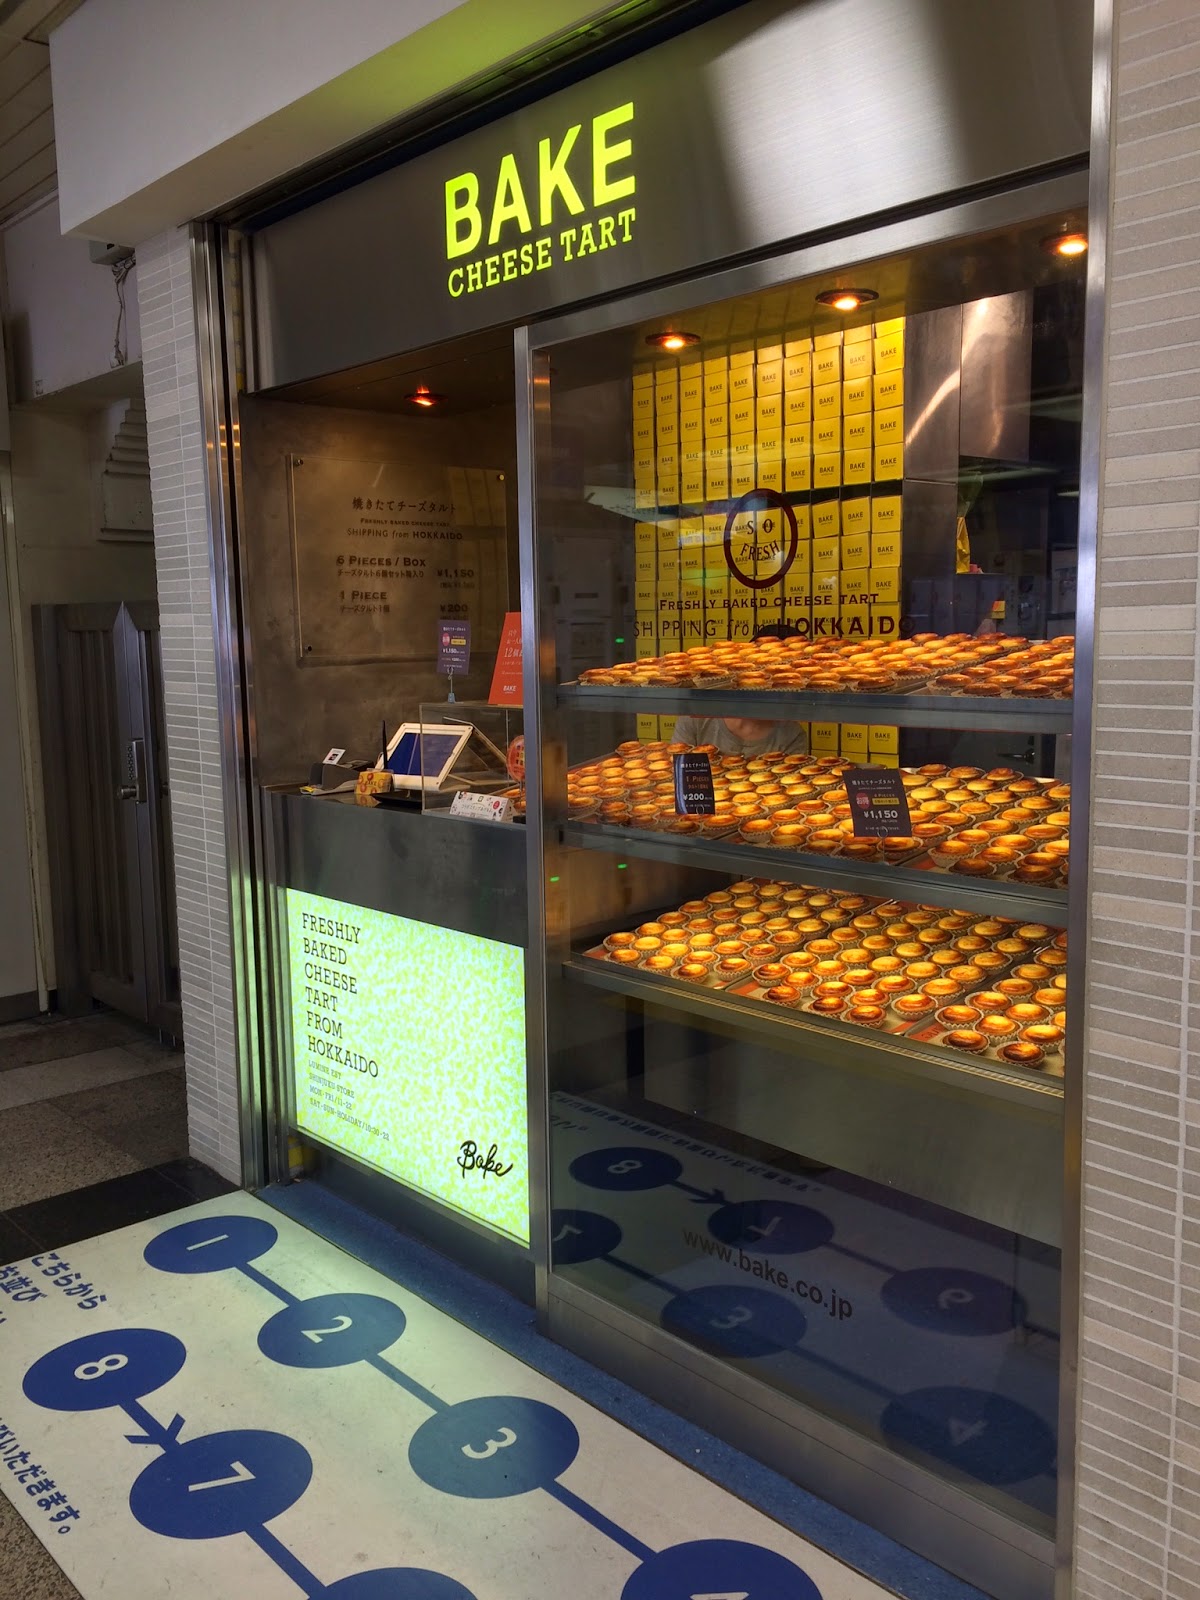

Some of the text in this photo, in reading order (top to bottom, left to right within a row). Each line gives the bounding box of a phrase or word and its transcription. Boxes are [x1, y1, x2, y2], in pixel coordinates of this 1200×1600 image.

[445, 101, 636, 260] BAKE
[448, 207, 636, 298] CHEESE TART
[880, 347, 897, 357] BAKE
[850, 355, 866, 364] BAKE
[818, 361, 834, 370] BAKE
[789, 367, 804, 376] BAKE
[762, 373, 777, 381] BAKE
[734, 379, 748, 387] BAKE
[709, 384, 723, 392] BAKE
[880, 384, 896, 393] BAKE
[660, 394, 673, 402] BAKE
[848, 391, 864, 400] BAKE
[637, 399, 650, 407] BAKE
[819, 396, 834, 405] BAKE
[790, 402, 805, 410] BAKE
[880, 421, 897, 430] BAKE
[818, 431, 834, 439] BAKE
[849, 427, 865, 435] BAKE
[762, 440, 776, 448] BAKE
[790, 436, 804, 444] BAKE
[736, 444, 749, 452] BAKE
[880, 457, 897, 465] BAKE
[850, 462, 865, 470] BAKE
[352, 496, 456, 514] 焼きたてチーズタルト
[818, 515, 833, 523] BAKE
[848, 512, 863, 520] BAKE
[347, 528, 463, 540] SHIPPING from HOKKAIDO
[740, 539, 780, 560] FRESH
[818, 550, 833, 558] BAKE
[336, 555, 426, 567] 6 PIECES / BOX
[438, 569, 474, 578] ¥1,150
[340, 590, 387, 600] 1 PIECE
[660, 594, 879, 610] FRESHLY BAKED CHEESE TART
[440, 604, 468, 612] ¥200
[633, 619, 716, 637] SHIPPING
[777, 616, 915, 636] HOKKAIDO
[864, 810, 898, 819] ¥1,150
[302, 912, 361, 944] FRESHLY
[303, 937, 348, 965] BAKED
[304, 962, 358, 995] CHEESE
[305, 986, 338, 1012] TART
[307, 1011, 343, 1039] FROM
[307, 1035, 379, 1078] HOKKAIDO
[457, 1140, 513, 1179] Bake
[186, 1234, 230, 1252] 1
[682, 1227, 853, 1321] www.bake.co.jp
[0, 1266, 48, 1302] お並び
[31, 1252, 107, 1310] こちらから
[300, 1315, 353, 1344] 2
[74, 1354, 128, 1380] 8
[461, 1426, 517, 1459] 3
